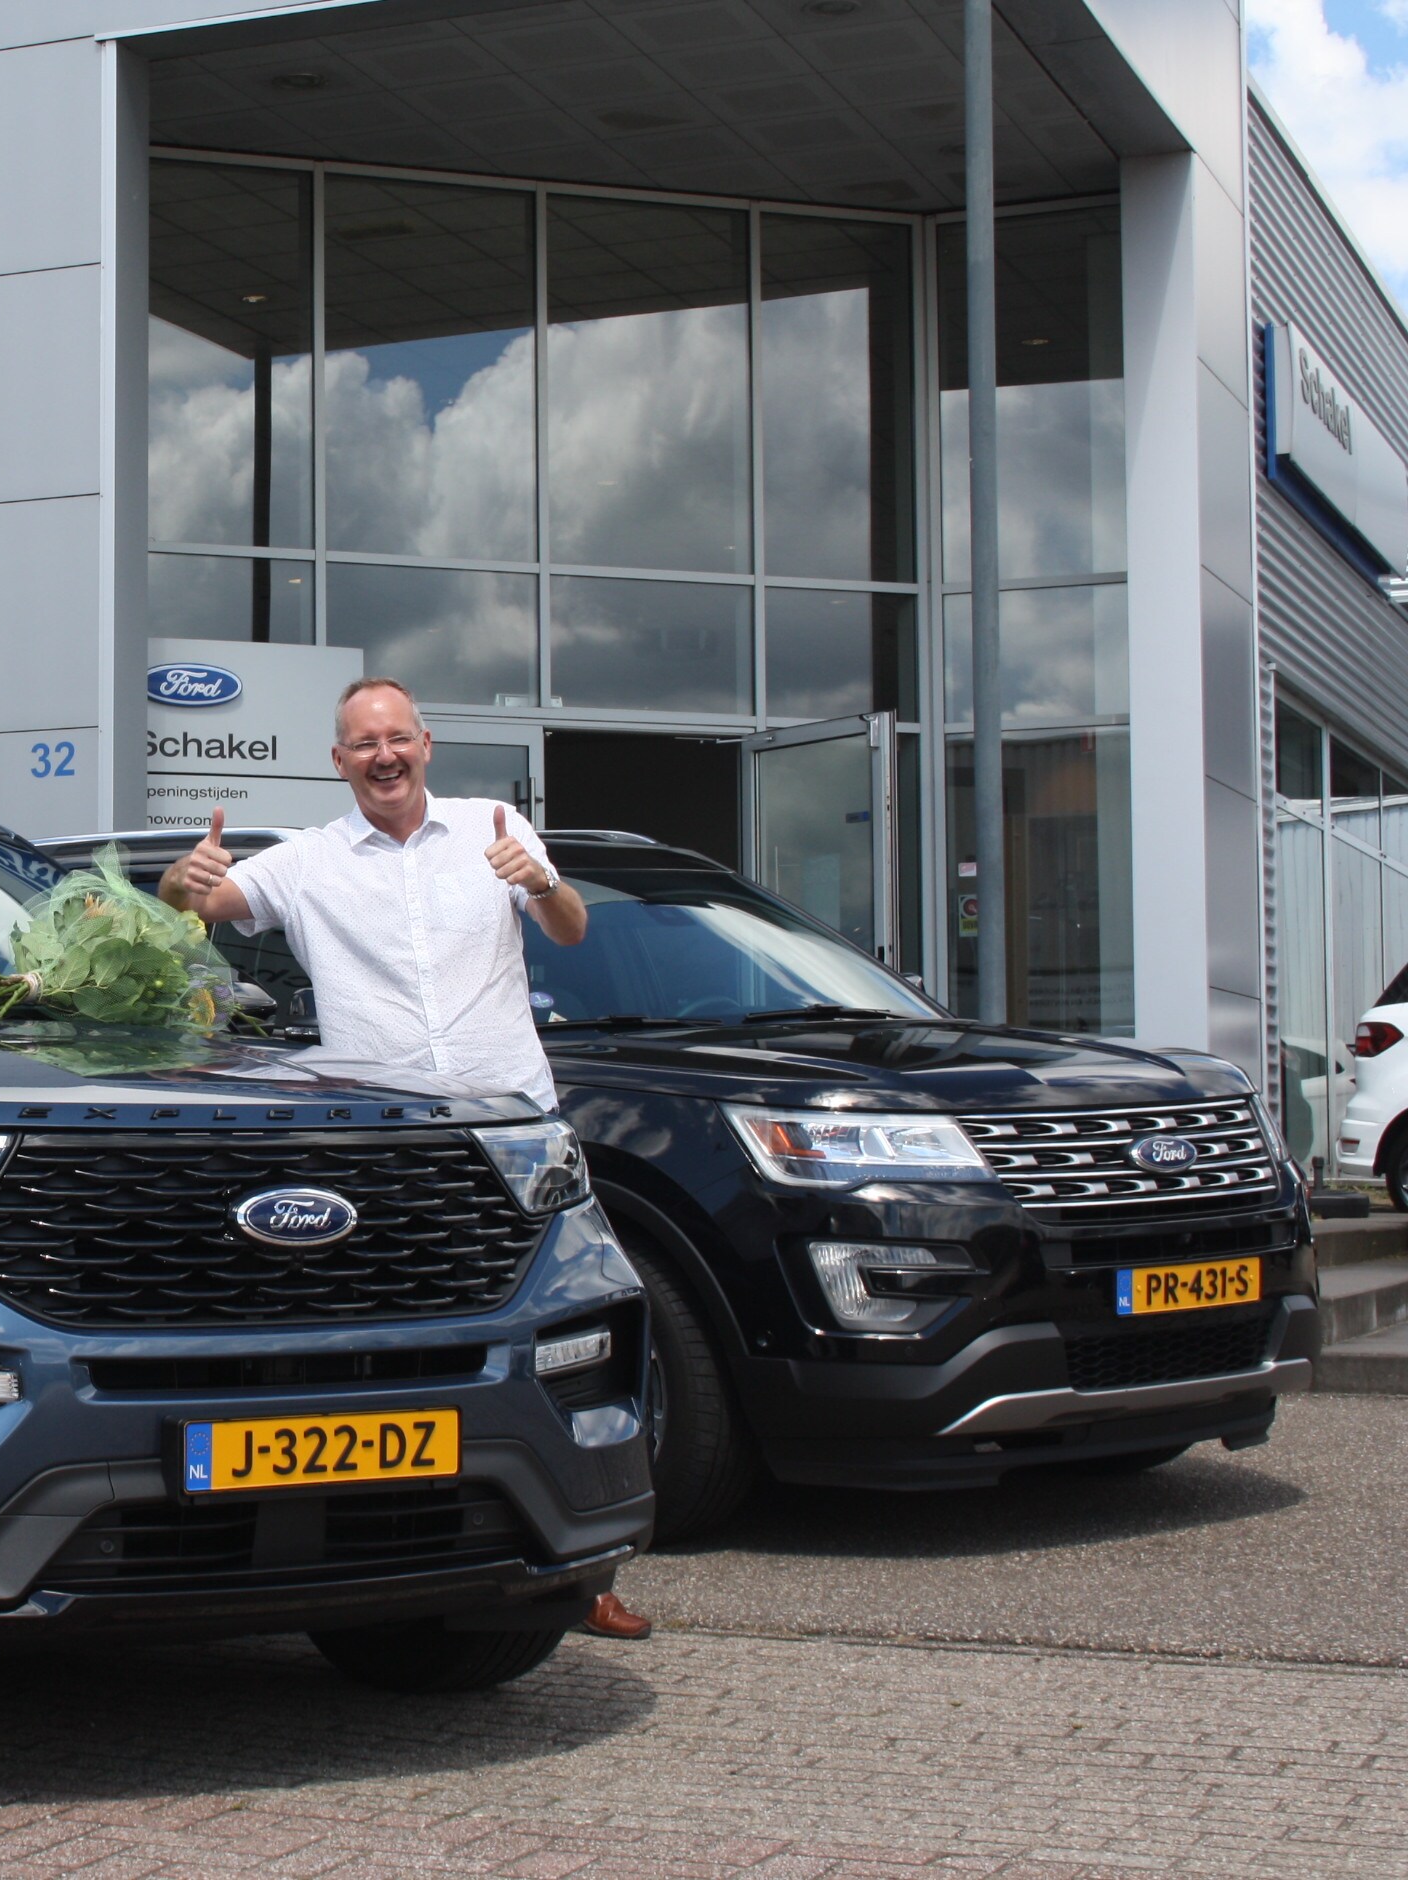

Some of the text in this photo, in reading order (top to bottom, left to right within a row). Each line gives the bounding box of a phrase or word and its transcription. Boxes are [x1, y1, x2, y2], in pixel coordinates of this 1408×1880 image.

[1298, 347, 1352, 456] Schakel
[159, 669, 224, 698] Ford
[30, 741, 76, 778] 32
[147, 730, 277, 761] Schakel
[147, 785, 248, 801] peningstijden
[17, 1105, 453, 1121] EXPLORER
[1152, 1140, 1187, 1162] Ford
[269, 1199, 332, 1231] Ford
[1145, 1264, 1248, 1306] PR-431-S
[1118, 1295, 1131, 1308] NL
[231, 1420, 436, 1478] J-322-DZ
[189, 1464, 209, 1479] NL
